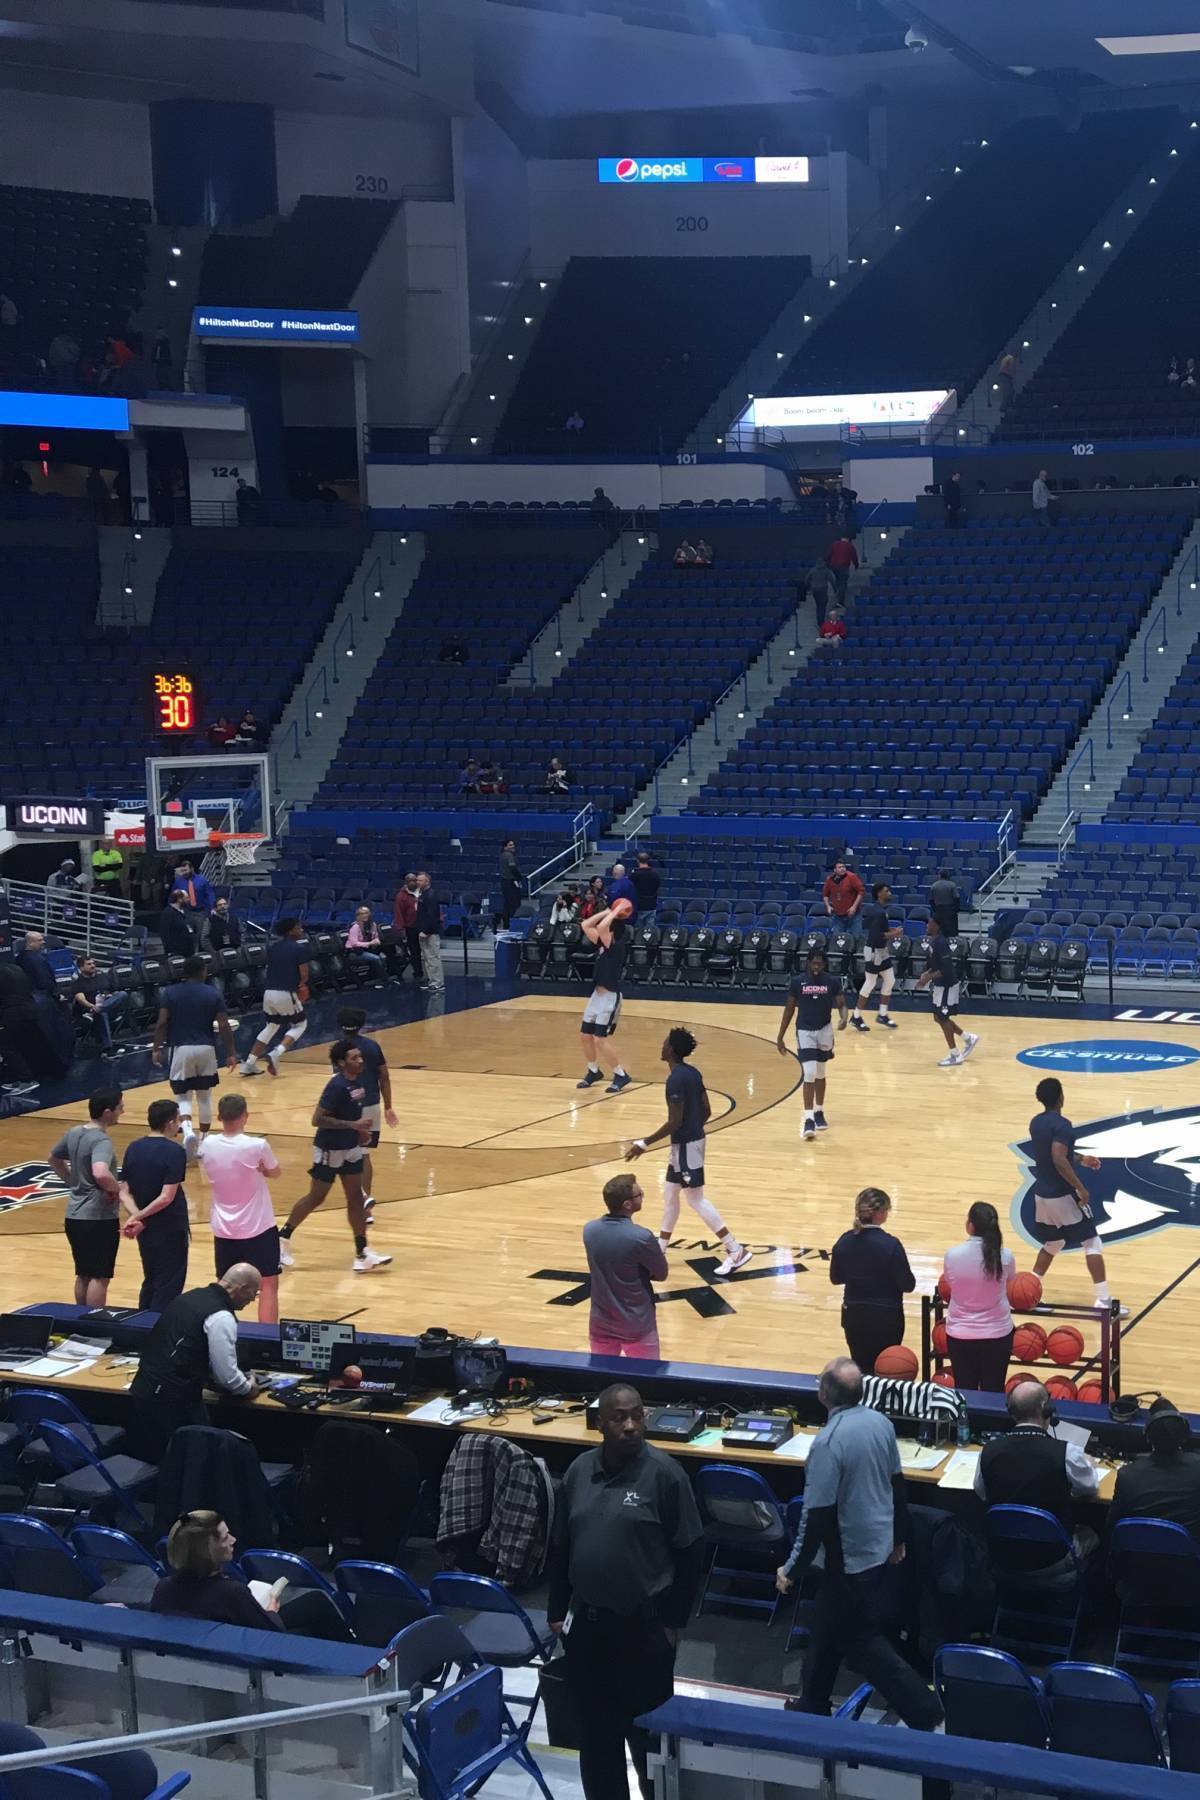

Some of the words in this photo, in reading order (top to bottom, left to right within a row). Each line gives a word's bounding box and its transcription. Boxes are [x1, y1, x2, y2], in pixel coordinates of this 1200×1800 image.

[640, 161, 688, 179] pepsi
[355, 175, 388, 193] 230
[676, 217, 709, 231] 200
[199, 317, 274, 329] #HiltonNextDoor
[281, 320, 355, 332] #HiltonNextDoor
[1072, 444, 1095, 455] 102
[676, 454, 697, 464] 101
[211, 467, 240, 477] 124
[154, 674, 193, 693] 36:36
[160, 695, 190, 728] 30
[21, 805, 87, 825] UCONN
[623, 1491, 641, 1502] XL
